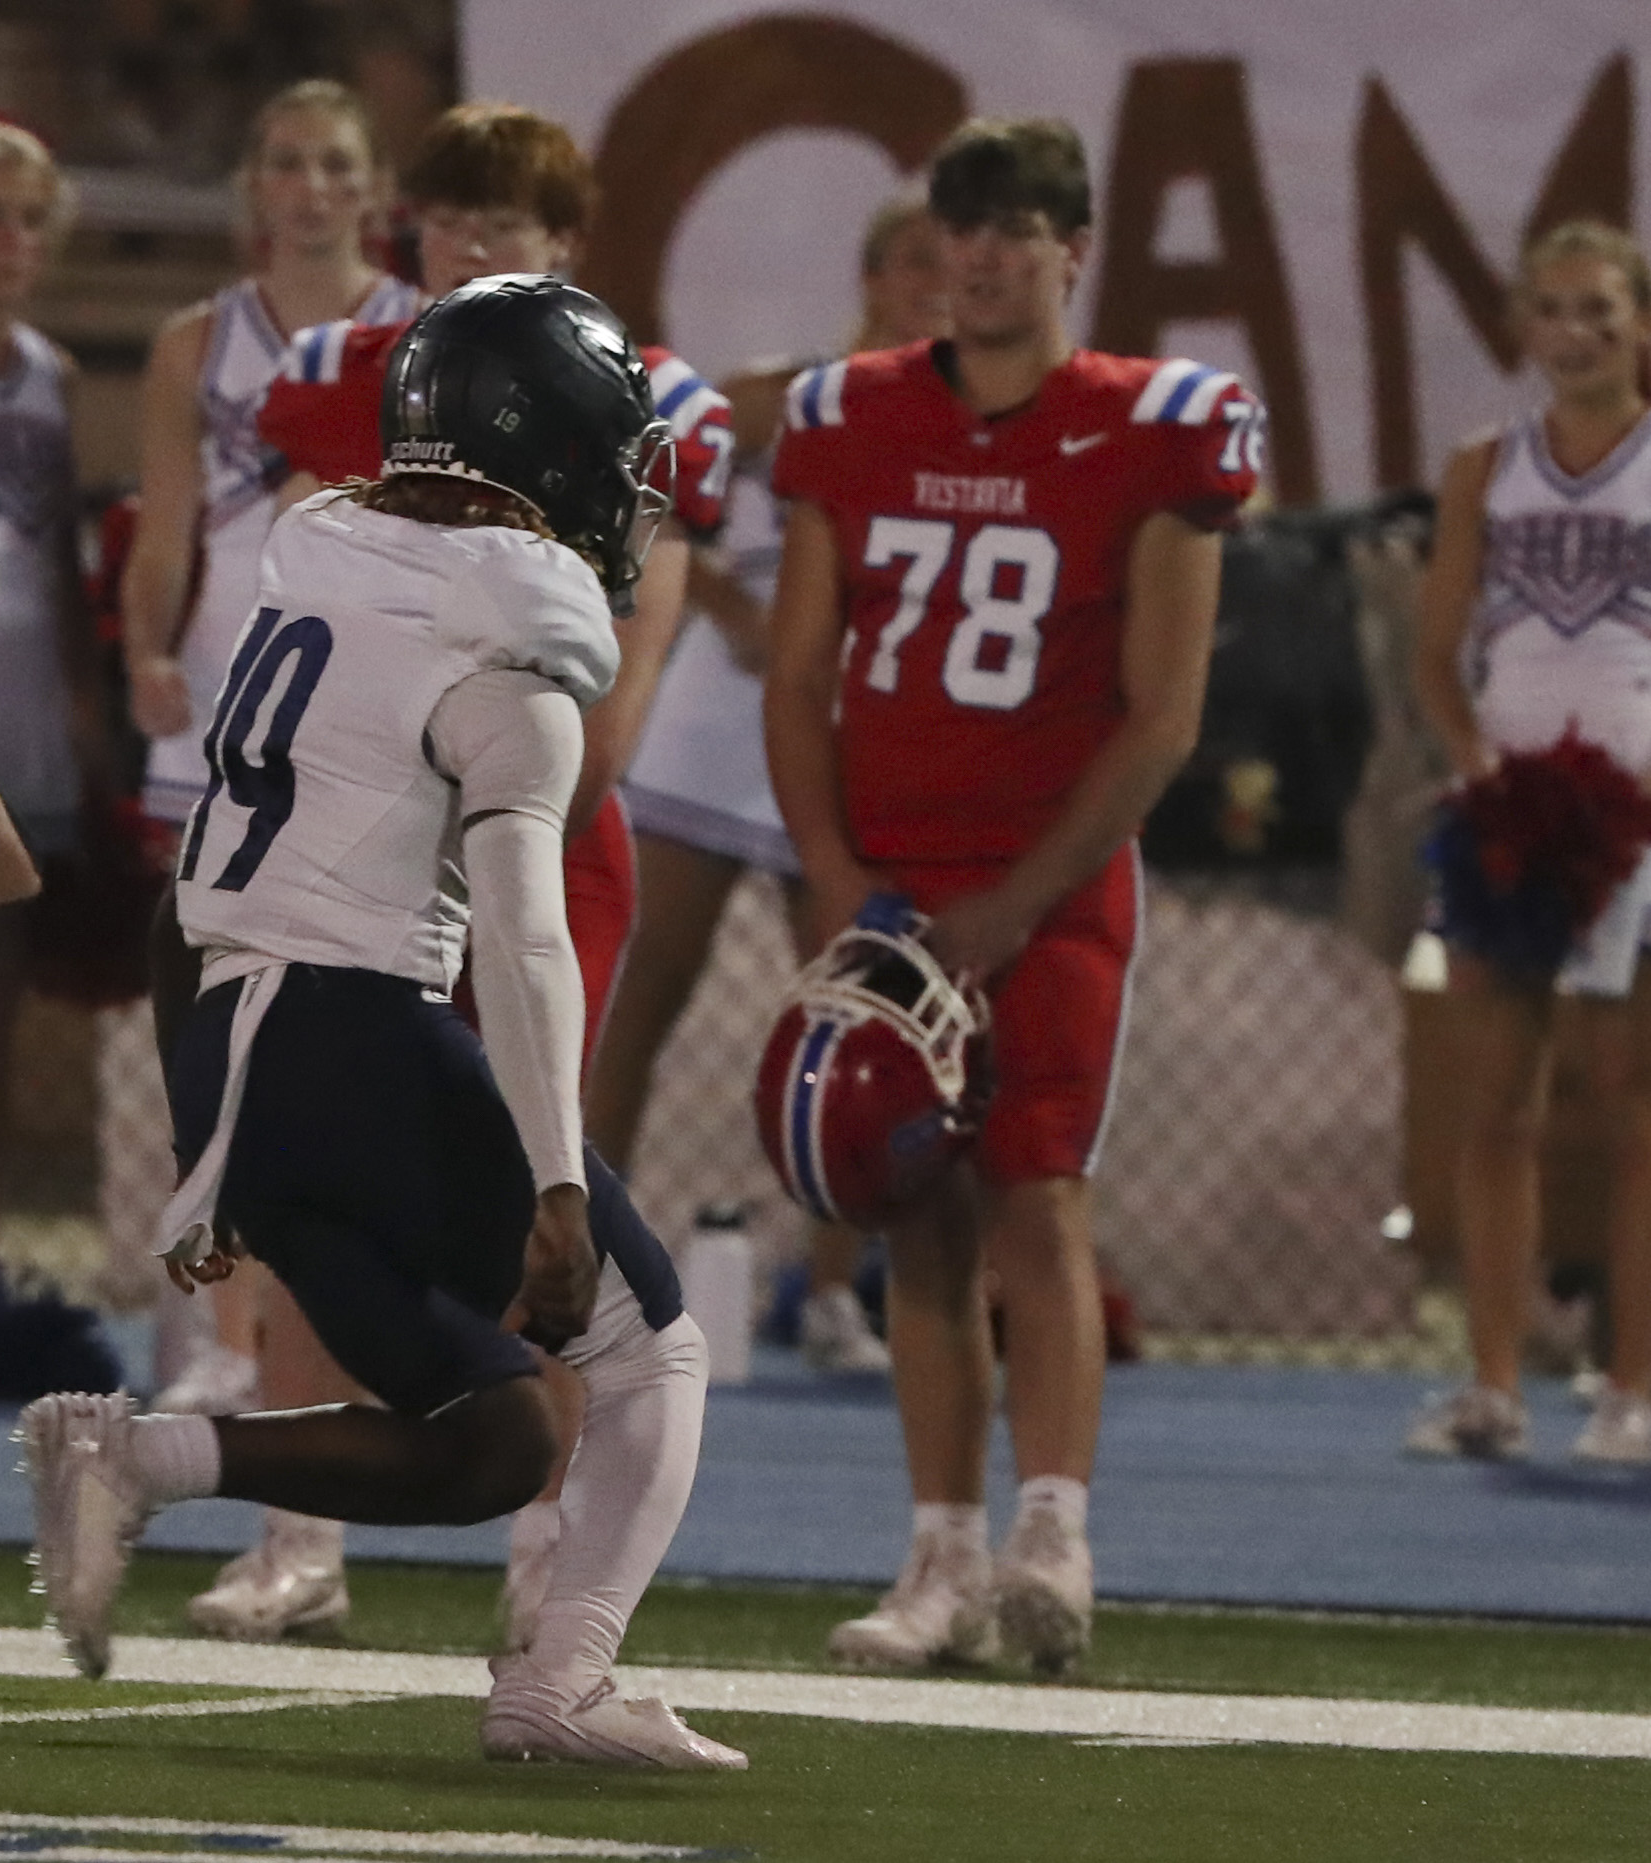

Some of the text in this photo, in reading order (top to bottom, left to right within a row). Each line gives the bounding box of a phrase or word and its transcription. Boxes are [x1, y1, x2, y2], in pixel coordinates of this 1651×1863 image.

[493, 407, 521, 433] 19
[862, 514, 1061, 711] 78
[177, 606, 334, 893] 19
